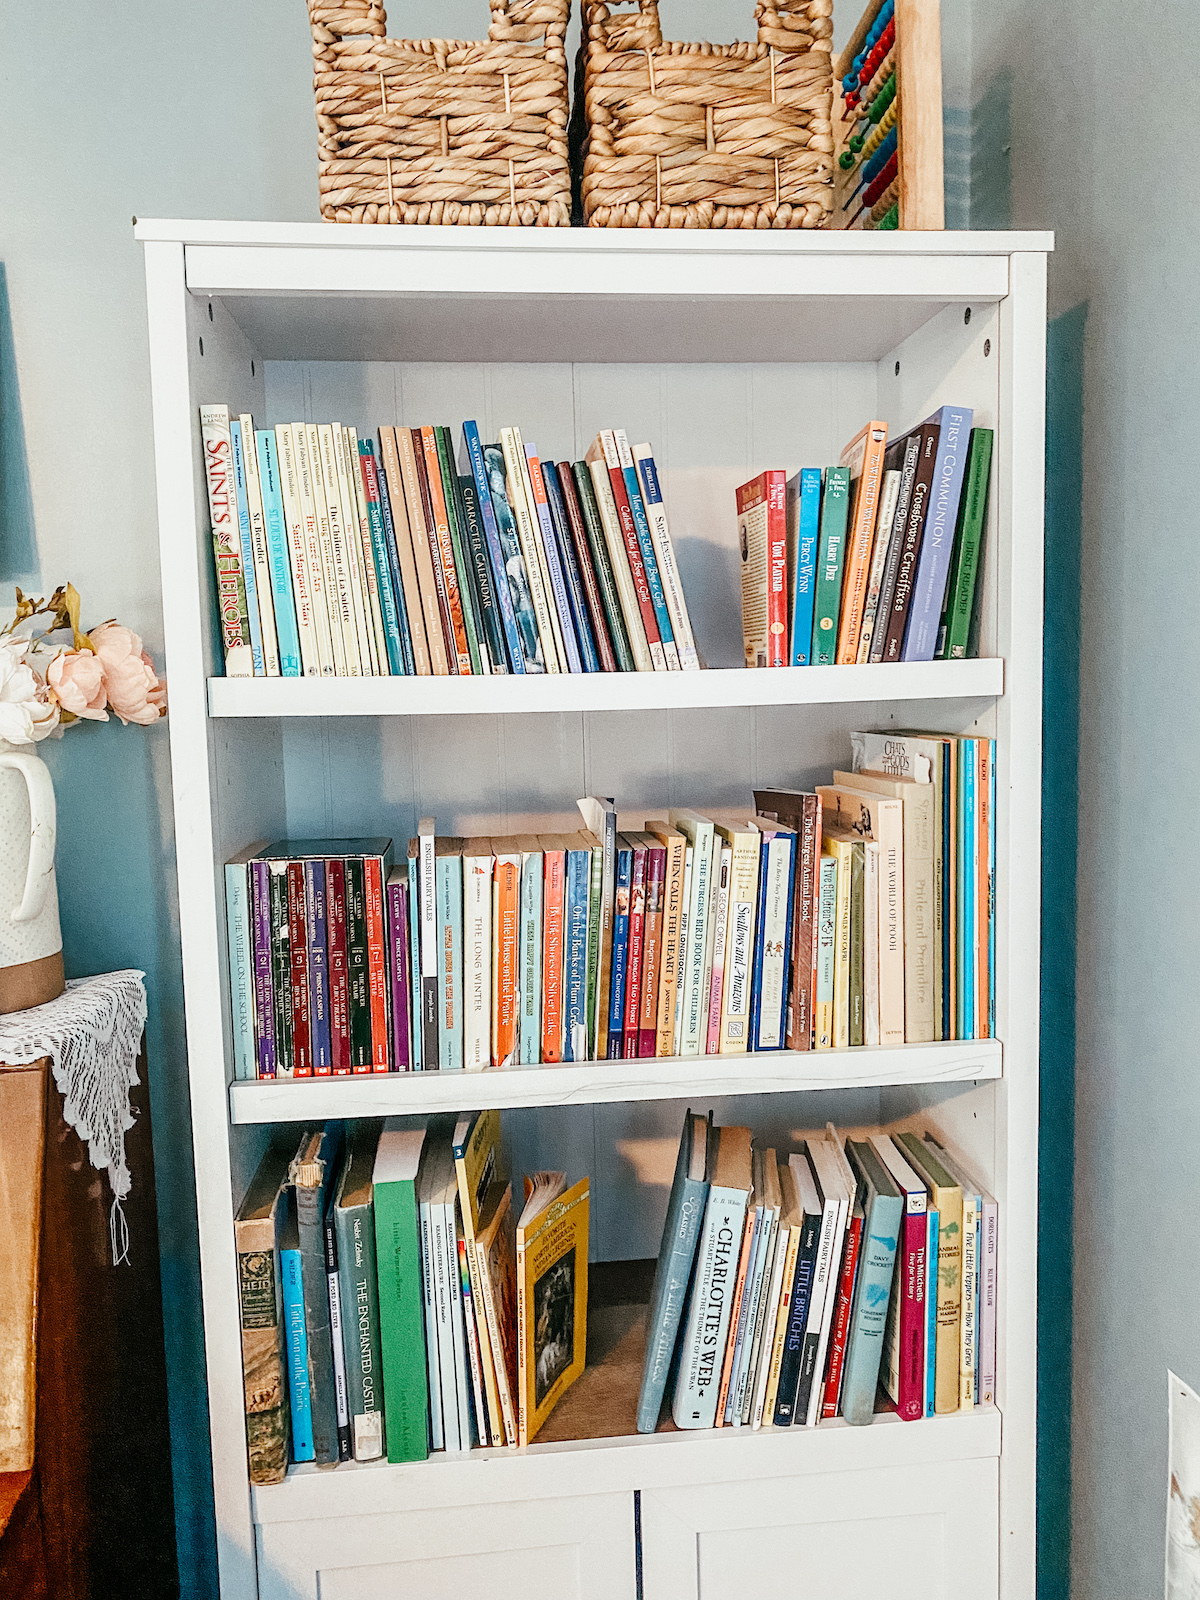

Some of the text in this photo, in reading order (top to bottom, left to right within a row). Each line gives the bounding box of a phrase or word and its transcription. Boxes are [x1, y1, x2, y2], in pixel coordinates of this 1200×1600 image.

[929, 413, 963, 549] FIRST COMMUNION
[205, 438, 244, 649] SAINTS & HEROES
[359, 516, 370, 539] Saint
[436, 522, 453, 566] CRUSADER
[461, 486, 492, 609] CHARACTER CALENDAR
[531, 464, 570, 629] GARNETT FLORENCE NIGHTINGALE'S NUNS
[892, 481, 928, 612] Crossbows & Crucifixes
[267, 508, 287, 594] ST. LOUIS DE MONTFORT
[328, 503, 351, 623] The Children of La Salette
[362, 541, 373, 560] Rose
[365, 561, 375, 572] of
[469, 436, 522, 669] VAN STEENWYK WATTS
[771, 539, 785, 592] TOM PLAYFAIR
[798, 536, 814, 593] PERCY WYNN
[824, 535, 840, 581] HARRY DEE
[237, 509, 263, 669] SAINT THOMAS AQUINAS TAN
[251, 511, 276, 670] St. Benedict TAN
[290, 522, 311, 628] Saint Margaret Mary
[366, 573, 377, 594] Lima
[443, 567, 456, 589] KING
[957, 540, 974, 615] FIRST READER
[671, 844, 682, 878] WHEN
[669, 879, 680, 912] CALLS
[887, 847, 896, 951] THE WORLD OF POOH
[423, 842, 435, 1023] ENGLISH FAIRY TALES Joseph Jacobs
[473, 916, 482, 937] THE
[502, 909, 514, 934] Little
[667, 913, 678, 937] THE
[734, 903, 750, 946] Swallows
[798, 816, 812, 1033] The Burgess Animal Book Living Book Press
[473, 940, 482, 968] LONG
[501, 935, 514, 964] House
[665, 938, 676, 975] HEART
[676, 912, 687, 989] PIPPI LONGSTOCKING
[688, 857, 707, 1034] THE BURGESS BIRD BOOK FOR CHILDREN
[710, 891, 726, 1028] GEORGE ORWELL ANIMAL FARM
[733, 946, 748, 965] and
[233, 913, 248, 1035] THE WHEEL ON THE SCHOOL
[501, 965, 513, 977] on
[501, 978, 513, 993] the
[730, 965, 747, 1013] Amazons
[473, 972, 482, 1012] WINTER
[500, 994, 513, 1026] Prairie
[663, 988, 671, 1012] JANETTE
[677, 1200, 694, 1239] CLASSICS
[964, 1231, 975, 1247] Five
[433, 1223, 448, 1324] READING-LITERATURE Second Reader
[445, 1222, 459, 1301] READING-LITERATURE PRIMER
[872, 1254, 889, 1262] DAVY
[906, 1252, 916, 1299] Five for Victory
[914, 1246, 924, 1302] The Mitchells
[964, 1248, 974, 1270] Little
[986, 1267, 994, 1283] BLUE
[355, 1278, 368, 1303] THE
[787, 1228, 814, 1352] LITTLE BRITCHES Moody
[963, 1270, 973, 1301] Peppers
[288, 1302, 302, 1328] Little
[687, 1233, 715, 1390] STUART LITTLE THE TRUMPET OF THE SWAN
[696, 1226, 734, 1387] CHARLOTTE'S WEB
[964, 1311, 973, 1328] How
[290, 1326, 304, 1353] Town
[357, 1304, 372, 1374] ENCHANTED
[650, 1277, 682, 1386] A Little Princess
[964, 1328, 973, 1346] They
[291, 1352, 305, 1365] on
[292, 1365, 306, 1383] the
[963, 1347, 973, 1367] Grew
[293, 1381, 308, 1413] Prairie
